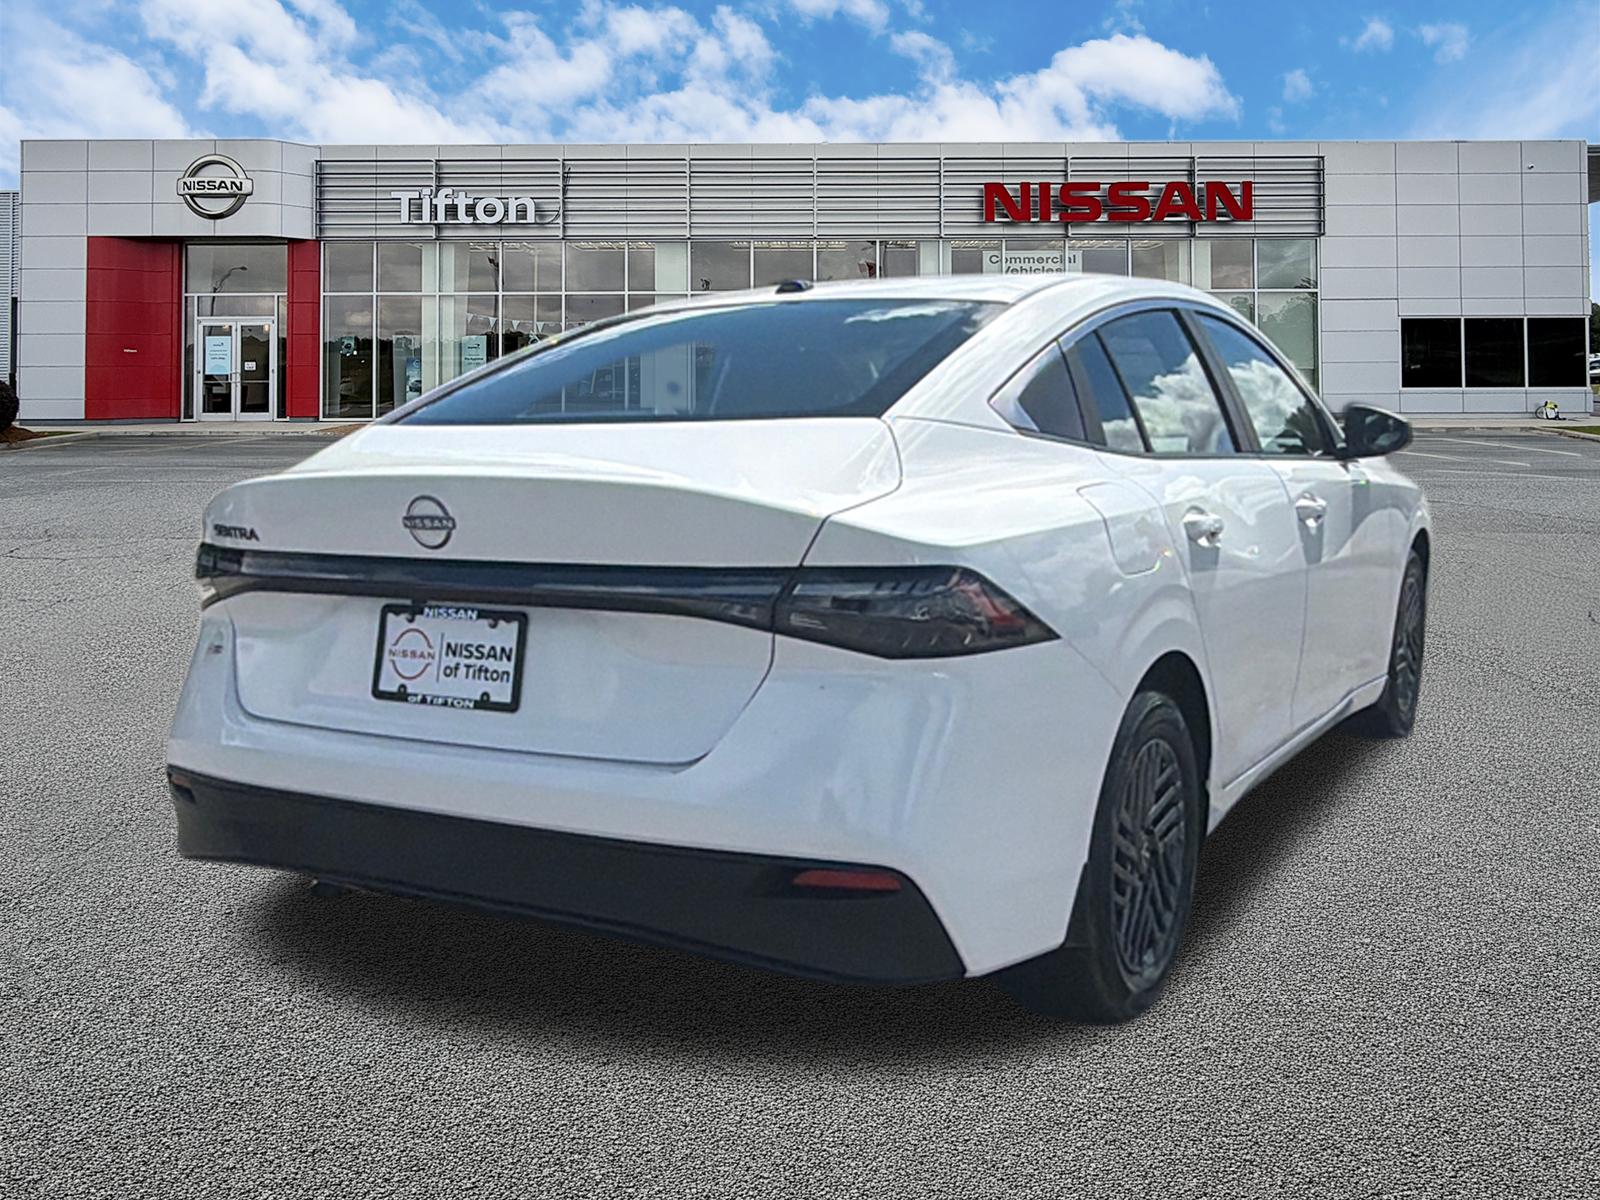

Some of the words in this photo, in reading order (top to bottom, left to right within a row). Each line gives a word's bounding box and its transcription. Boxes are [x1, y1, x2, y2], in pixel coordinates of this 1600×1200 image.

[182, 180, 243, 191] NISSAN
[391, 188, 536, 224] Tifton
[982, 181, 1254, 222] NISSAN
[403, 518, 454, 529] NISSAN
[423, 607, 478, 620] NISSAN
[388, 648, 435, 660] NISSAN
[445, 642, 513, 662] NISSAN
[443, 663, 461, 678] of
[464, 664, 511, 683] Tifton
[408, 695, 422, 703] of
[426, 697, 475, 708] TIFTON
